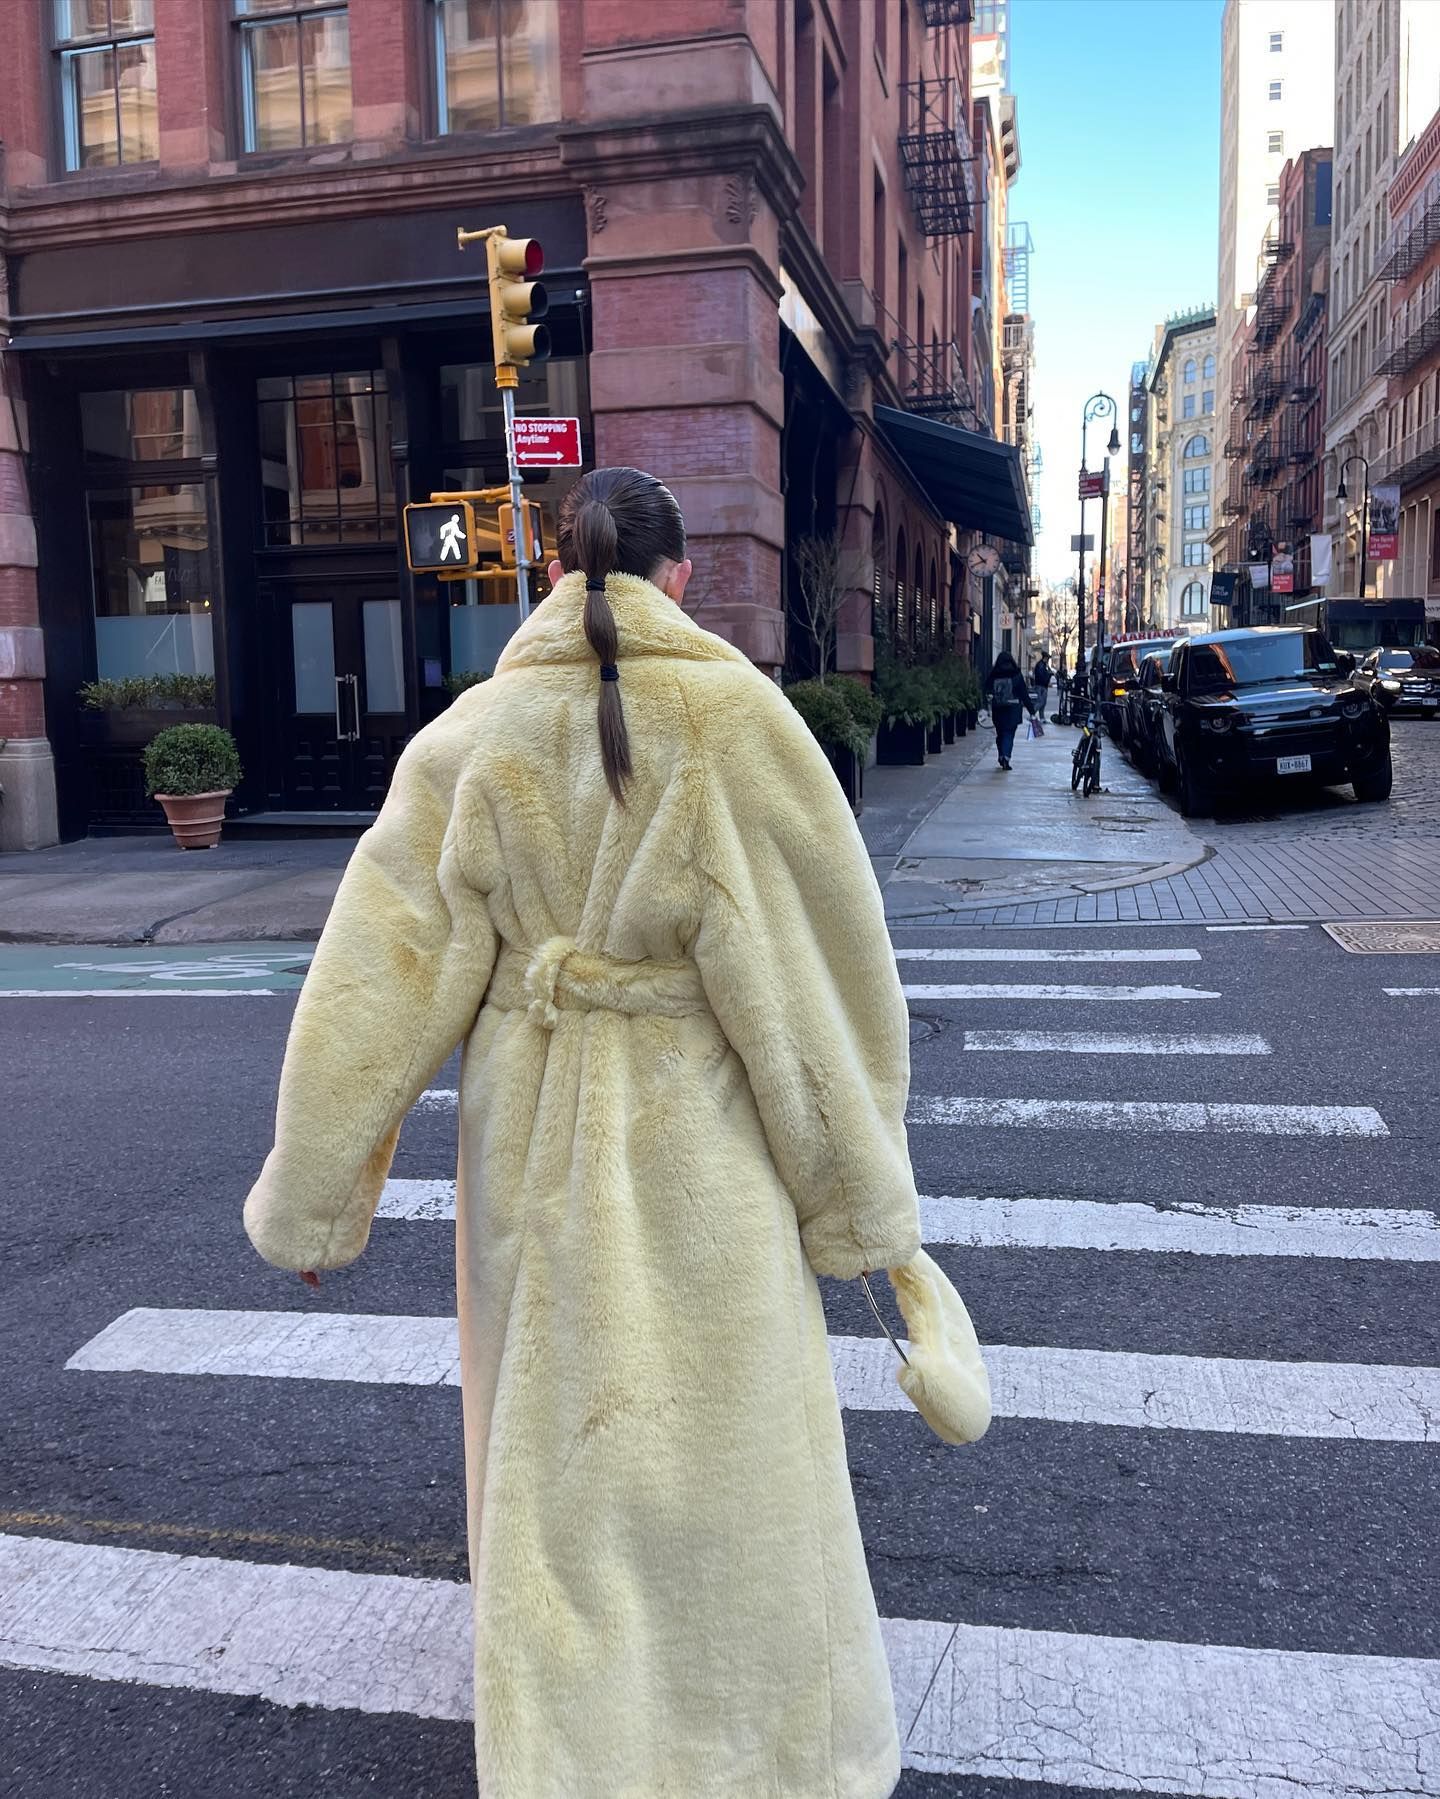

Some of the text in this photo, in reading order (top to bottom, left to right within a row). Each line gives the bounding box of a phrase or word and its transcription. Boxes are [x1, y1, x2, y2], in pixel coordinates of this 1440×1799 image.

[515, 423, 567, 433] NO STOPPING
[517, 434, 550, 446] Anytime
